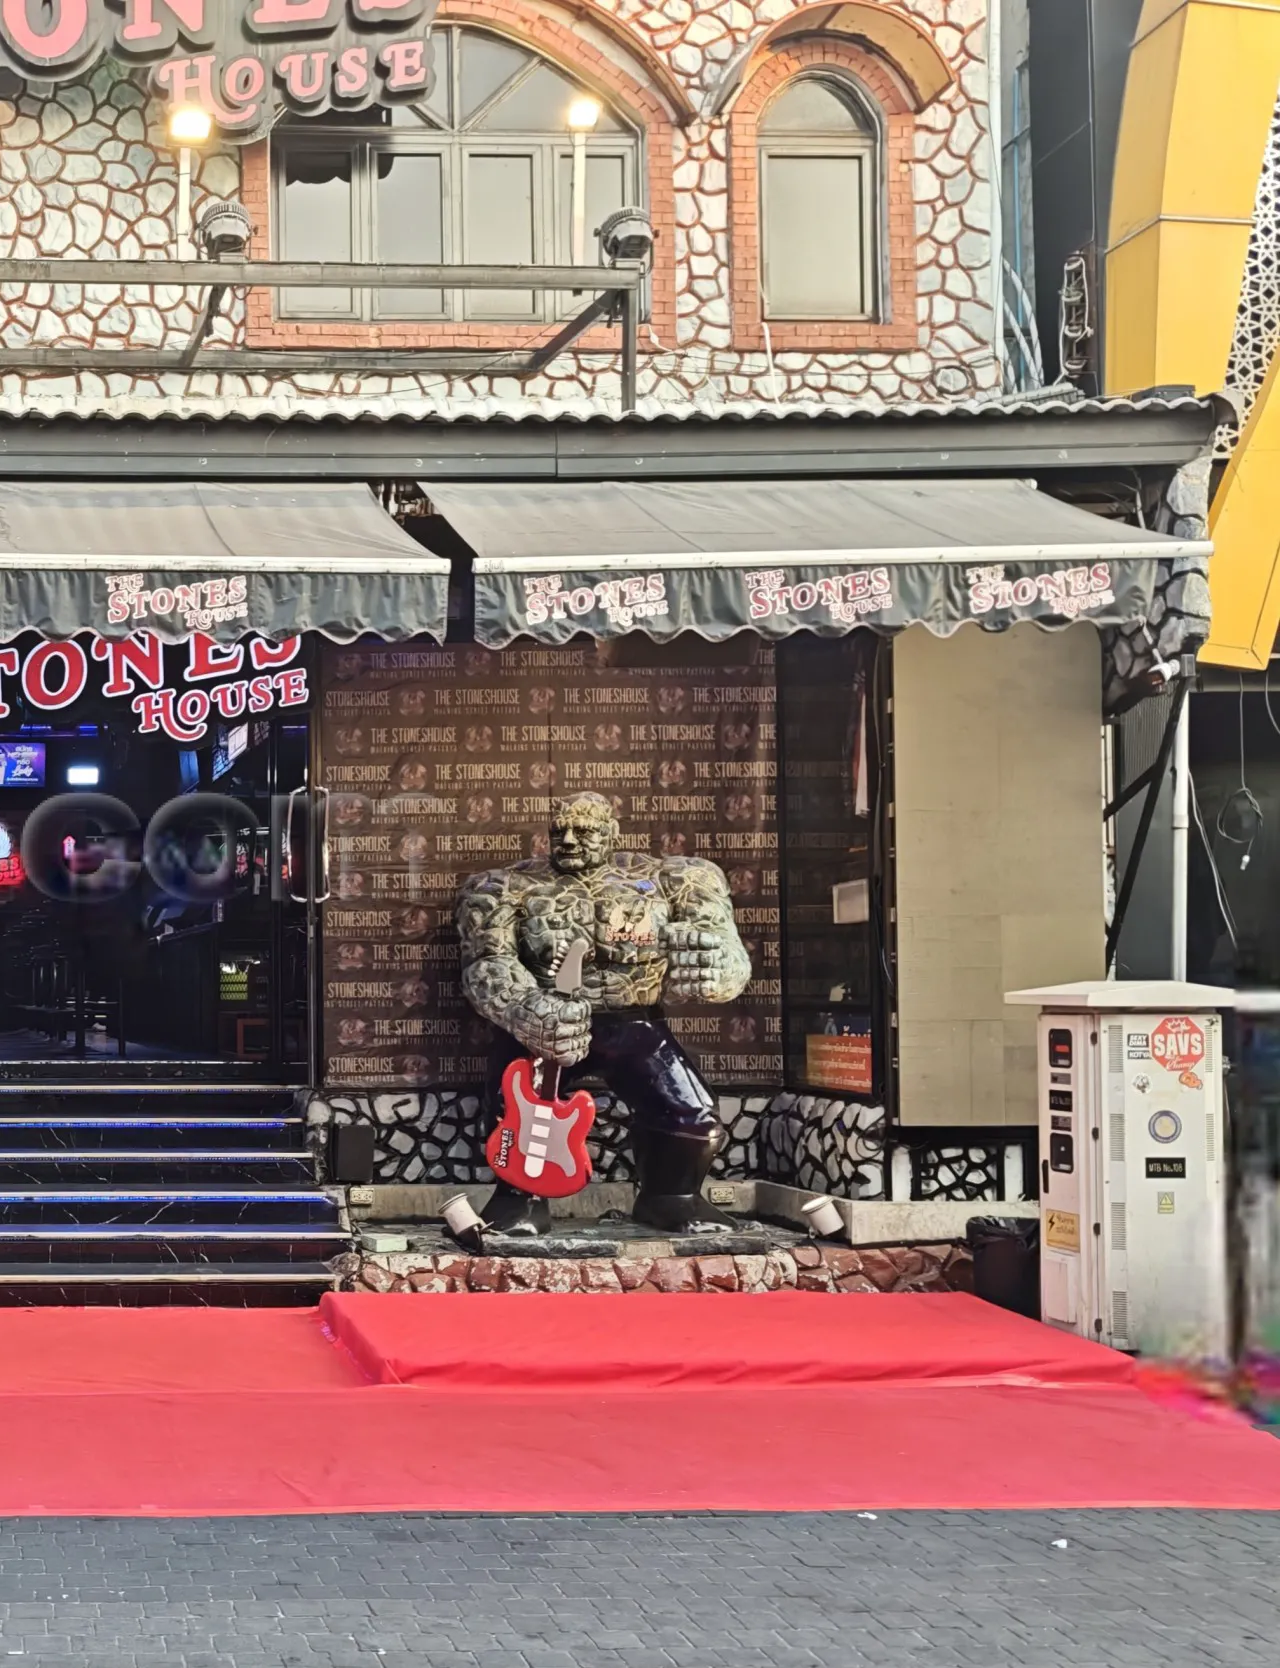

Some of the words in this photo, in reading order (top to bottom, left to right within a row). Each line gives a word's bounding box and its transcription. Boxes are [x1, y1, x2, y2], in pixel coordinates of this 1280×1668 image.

[160, 42, 427, 122] HOUSE
[746, 569, 784, 588] THE
[966, 564, 1004, 584] THE
[106, 573, 144, 592] THE
[524, 574, 562, 594] THE
[969, 562, 1110, 614] STONES
[108, 576, 246, 624] STONES
[526, 573, 666, 626] STONES
[750, 567, 890, 618] STONES
[830, 594, 892, 622] HOUSE
[1050, 590, 1115, 618] HOUSE
[184, 602, 248, 630] HOUSE
[607, 600, 669, 626] HOUSE
[371, 652, 387, 669] THE
[500, 652, 516, 667] THE
[520, 650, 584, 666] STONESHOUSE
[759, 649, 775, 664] THE
[325, 691, 390, 707] STONESHOUSE
[434, 689, 451, 705] THE
[455, 689, 520, 705] STONESHOUSE
[564, 688, 580, 704] THE
[584, 688, 649, 704] STONESHOUSE
[131, 668, 309, 742] HOUSE
[371, 727, 388, 743] THE
[392, 727, 457, 743] STONESHOUSE
[502, 726, 518, 742] THE
[522, 725, 586, 740] STONESHOUSE
[630, 725, 647, 741] THE
[651, 725, 716, 741] STONESHOUSE
[759, 724, 776, 739] THE
[326, 765, 391, 782] STONESHOUSE
[435, 763, 452, 780] THE
[456, 763, 521, 780] STONESHOUSE
[564, 762, 581, 778] THE
[586, 762, 651, 778] STONESHOUSE
[372, 799, 388, 814] THE
[393, 799, 458, 814] STONESHOUSE
[502, 797, 519, 813] THE
[631, 796, 648, 812] THE
[652, 796, 716, 812] STONESHOUSE
[760, 795, 777, 811] THE
[436, 834, 453, 851] THE
[457, 834, 522, 851] STONESHOUSE
[372, 873, 389, 889] THE
[393, 873, 458, 889] STONESHOUSE
[762, 870, 778, 886] THE
[327, 911, 392, 927] STONESHOUSE
[437, 911, 454, 925] THE
[373, 945, 389, 961] THE
[763, 941, 780, 957] THE
[328, 983, 393, 998] STONESHOUSE
[374, 1020, 391, 1035] THE
[395, 1020, 461, 1035] STONESHOUSE
[764, 1017, 781, 1032] THE
[1154, 1032, 1202, 1057] SAVS
[329, 1057, 394, 1073] STONESHOUSE
[498, 1129, 510, 1168] STONES
[1148, 1163, 1162, 1172] MTB
